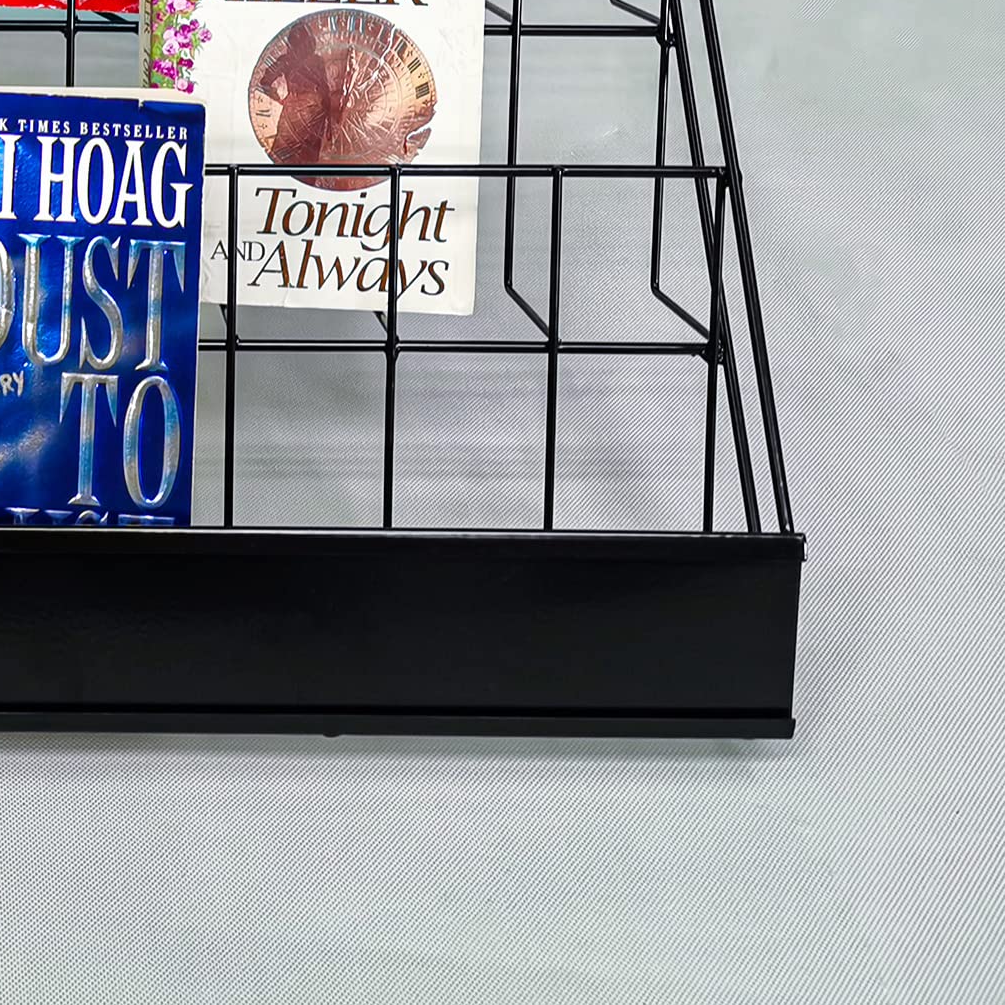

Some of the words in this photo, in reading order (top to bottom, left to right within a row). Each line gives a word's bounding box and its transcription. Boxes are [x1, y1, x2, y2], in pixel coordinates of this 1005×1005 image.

[18, 119, 70, 134] TIMES
[79, 123, 188, 140] BESTSELLER
[34, 136, 193, 228] HOAG
[255, 187, 455, 252] Tonight
[210, 240, 265, 262] AND
[247, 239, 449, 301] Always
[60, 372, 181, 508] TO
